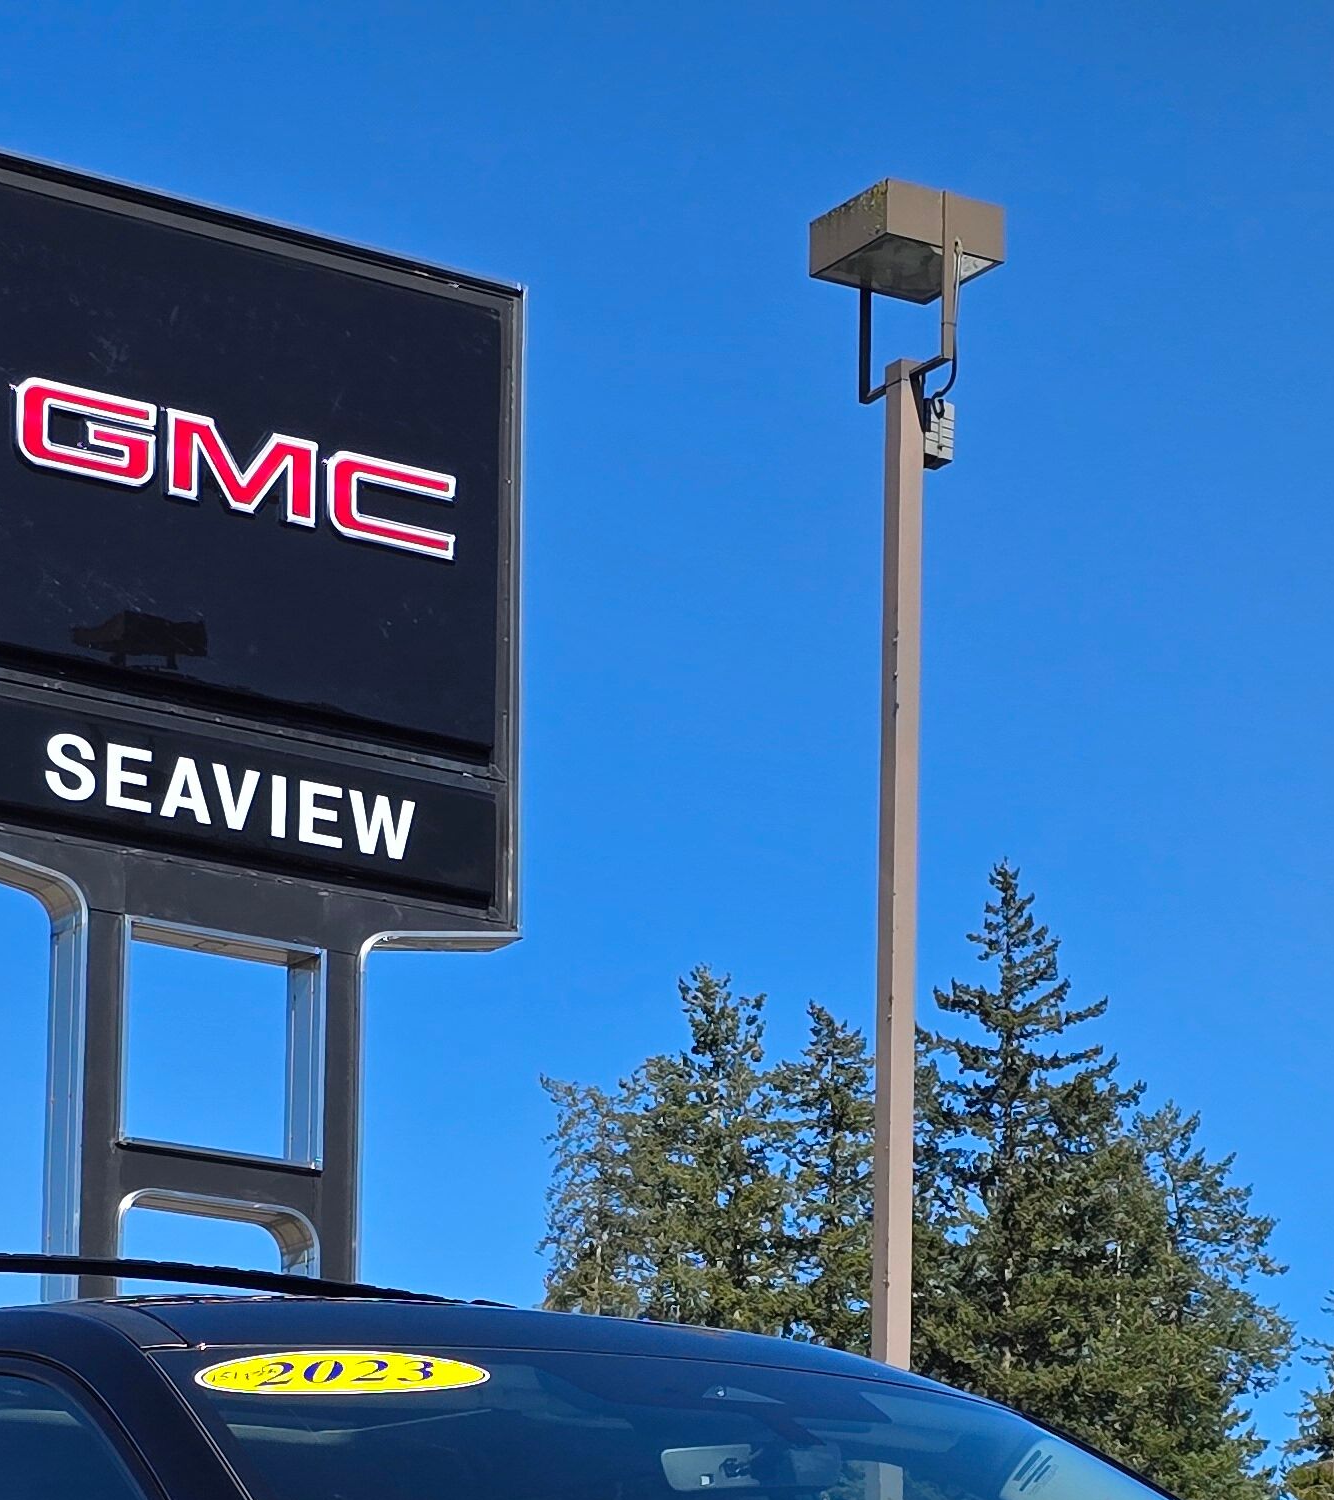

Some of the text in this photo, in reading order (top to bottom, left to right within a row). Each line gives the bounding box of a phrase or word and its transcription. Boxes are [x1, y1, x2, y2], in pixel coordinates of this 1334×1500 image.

[15, 377, 456, 560] GMC
[45, 733, 415, 860] SEAVIEW
[255, 1359, 433, 1387] 2023
